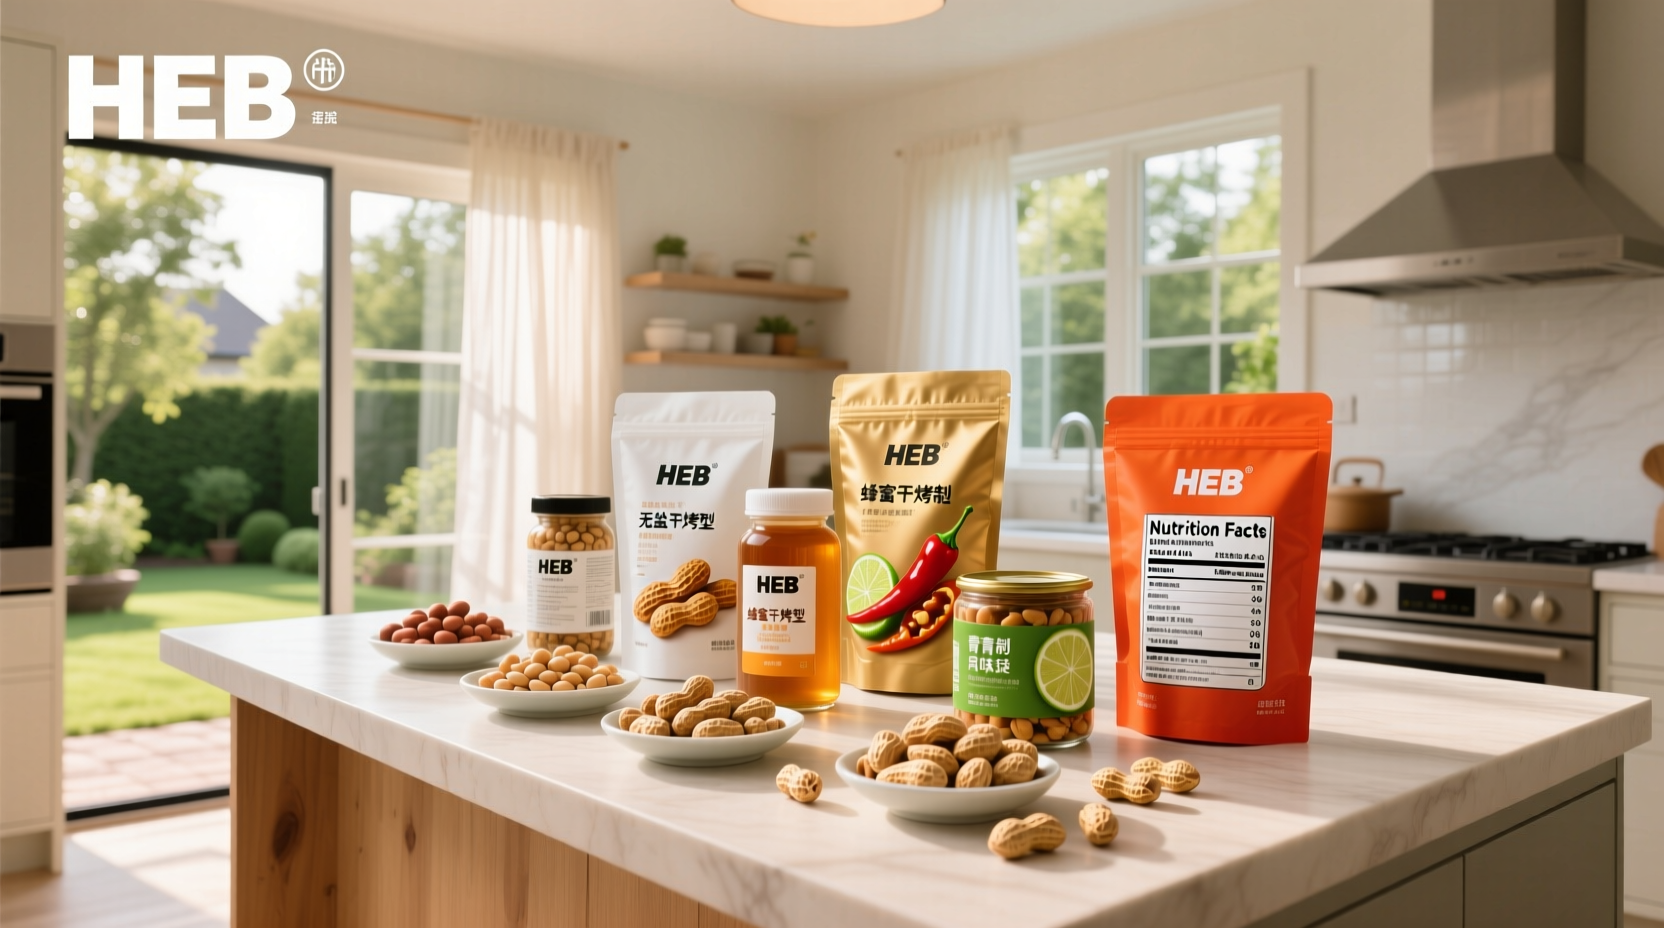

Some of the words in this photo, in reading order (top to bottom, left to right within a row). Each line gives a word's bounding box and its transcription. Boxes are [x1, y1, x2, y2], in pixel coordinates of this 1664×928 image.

[884, 444, 941, 466] HEB
[656, 464, 711, 486] HEB
[1173, 468, 1244, 496] HEB
[1150, 520, 1219, 537] Nutrition
[1225, 522, 1267, 539] Facts
[538, 558, 573, 575] HEB
[757, 575, 799, 594] HEB
